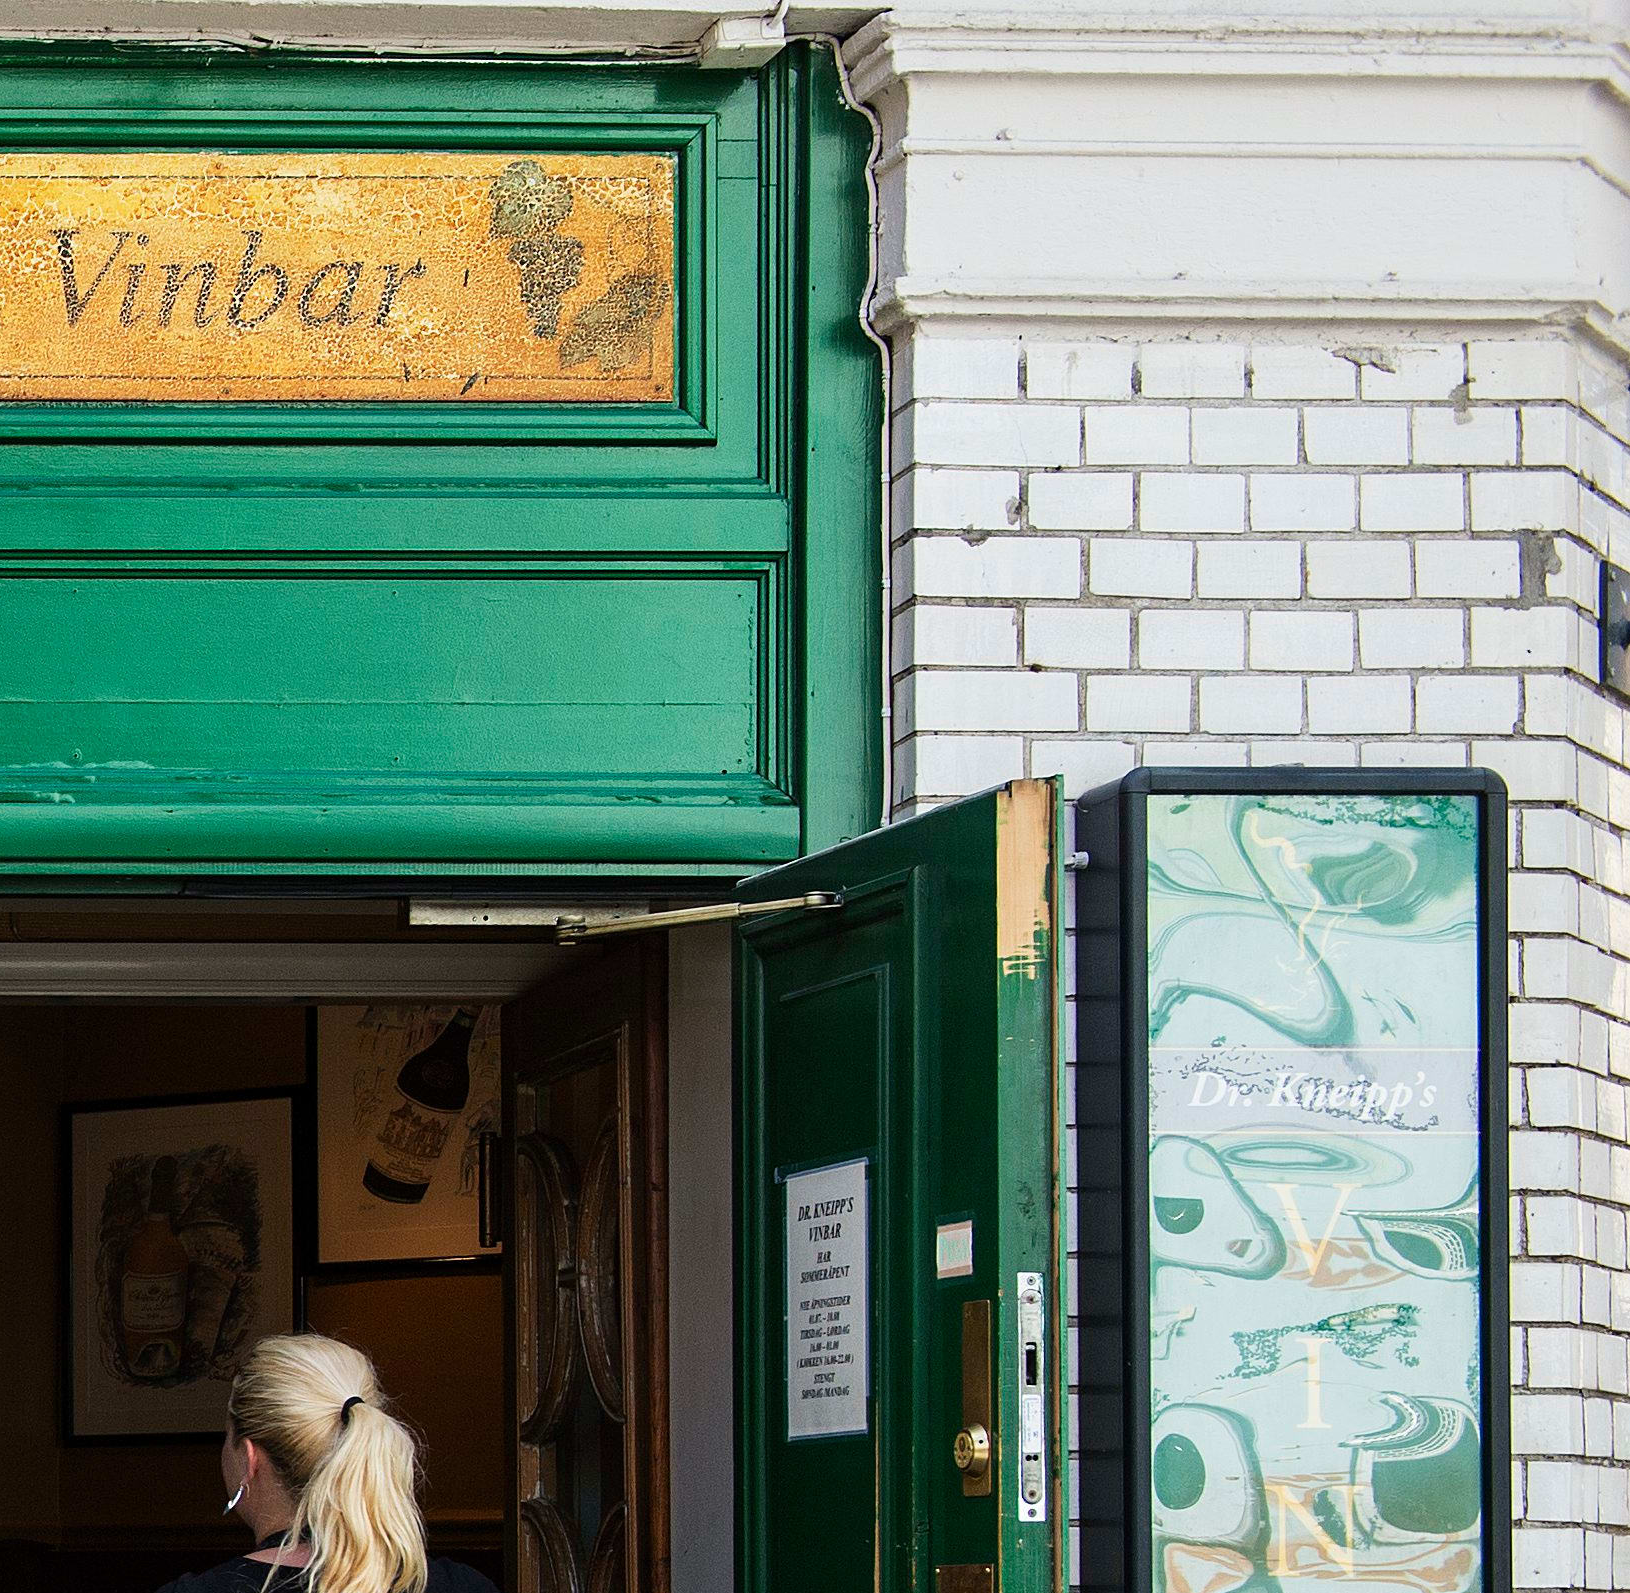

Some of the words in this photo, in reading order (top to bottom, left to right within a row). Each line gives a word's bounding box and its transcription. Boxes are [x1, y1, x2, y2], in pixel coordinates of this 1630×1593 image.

[50, 228, 427, 331] Vinbar
[1186, 1070, 1254, 1109] Dr.
[808, 1222, 842, 1242] VINBAR
